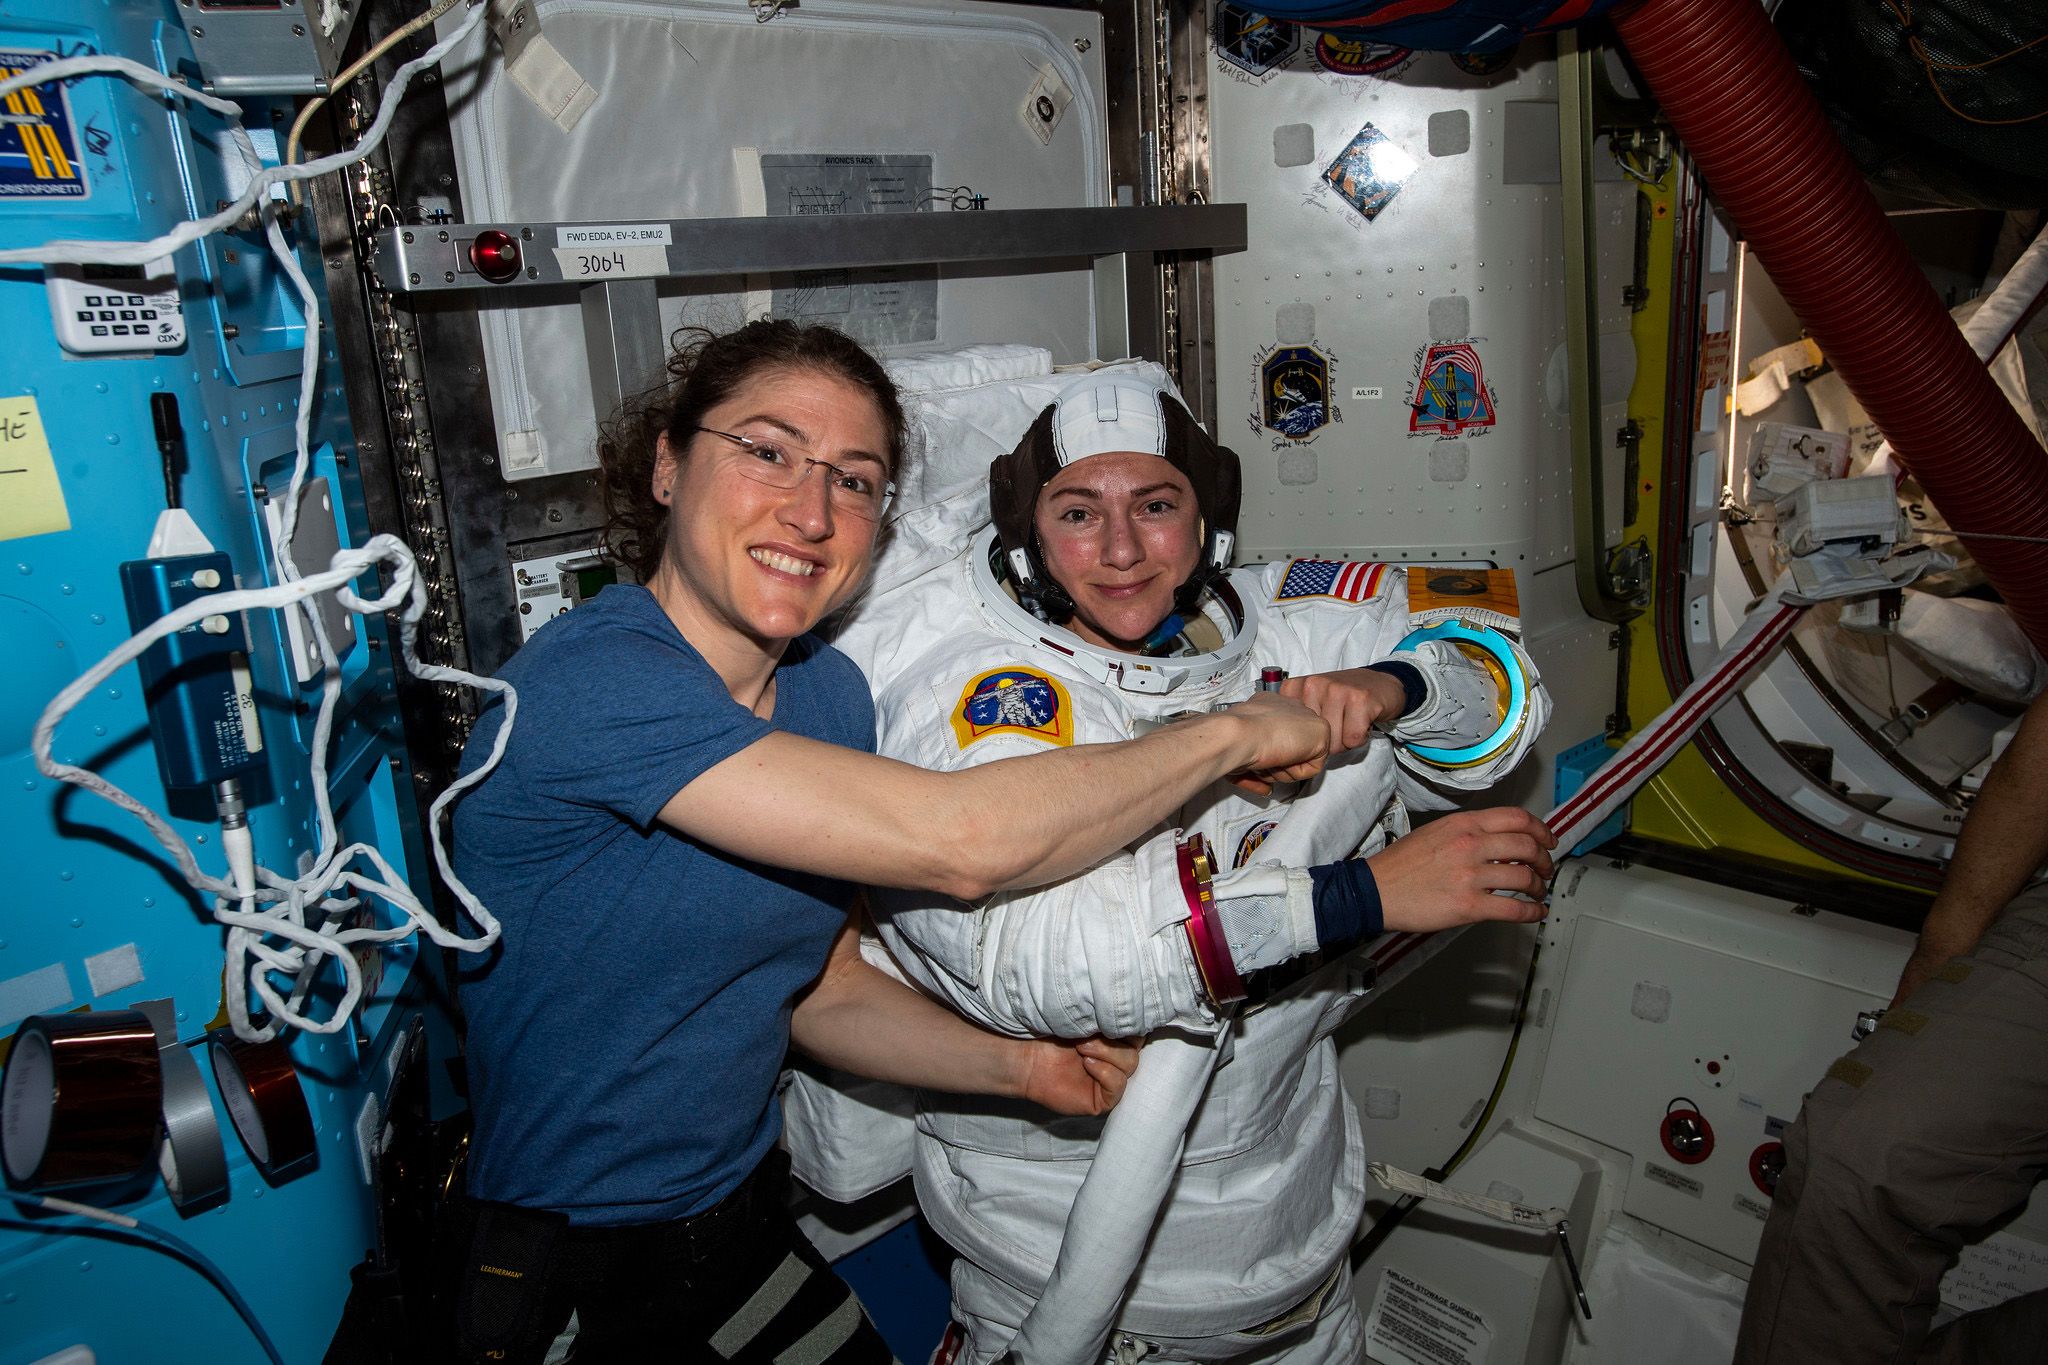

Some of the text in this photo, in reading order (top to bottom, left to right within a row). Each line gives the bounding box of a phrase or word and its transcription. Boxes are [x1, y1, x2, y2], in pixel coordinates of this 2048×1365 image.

[825, 156, 874, 165] AVIONICS RACK
[567, 230, 663, 242] FWD EDDA, EV-2, EMU2
[480, 1264, 521, 1279] LEATHERMAN
[1386, 1268, 1416, 1289] AIRLOCK
[1416, 1283, 1449, 1307] STOWAGE
